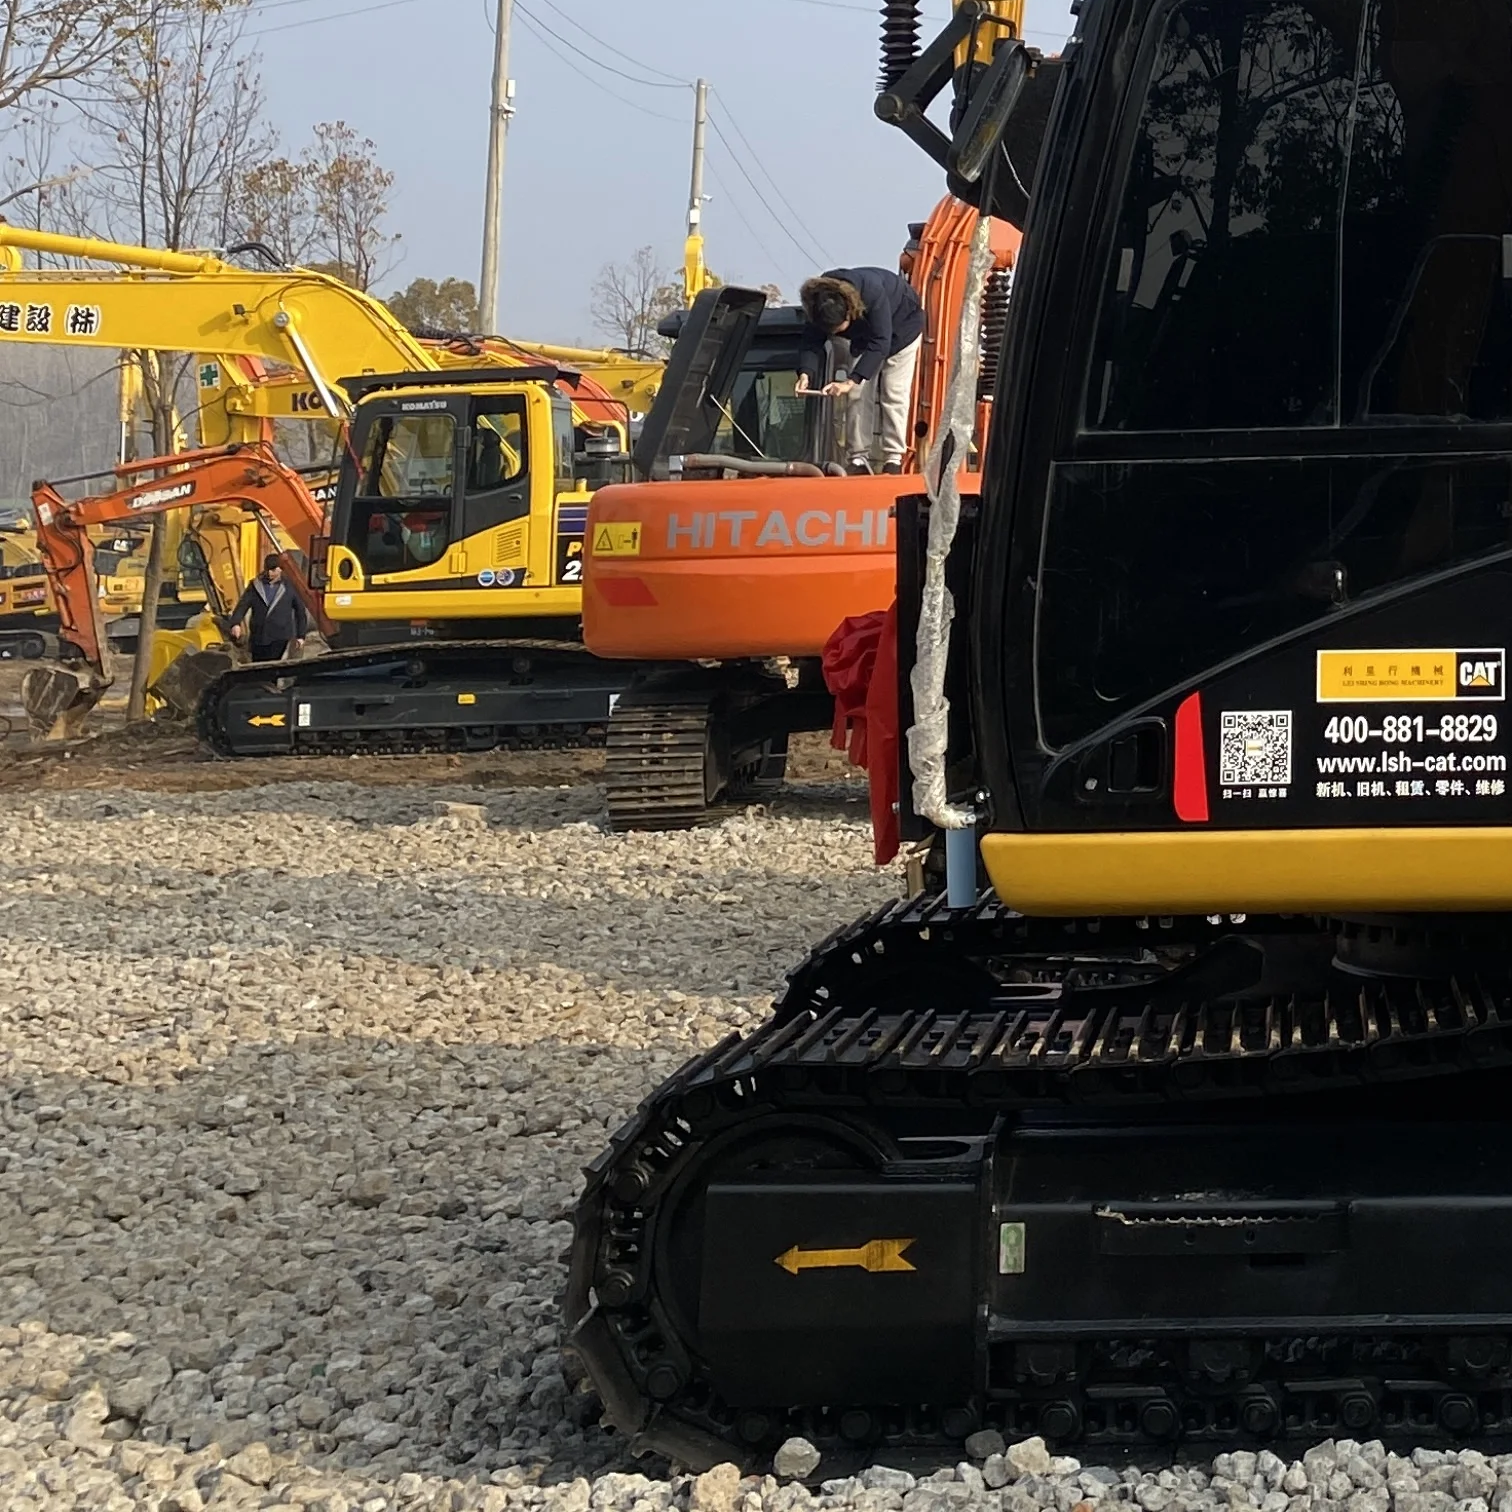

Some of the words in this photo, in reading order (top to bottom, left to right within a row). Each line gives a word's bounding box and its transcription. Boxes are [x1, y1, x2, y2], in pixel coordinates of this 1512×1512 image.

[291, 392, 324, 412] KO
[402, 400, 447, 411] KOMATSU
[667, 509, 889, 549] HITACHI
[1459, 662, 1499, 686] CAT
[1324, 715, 1498, 743] 400-881-8829
[1317, 751, 1506, 773] www.lsh-cat.com
